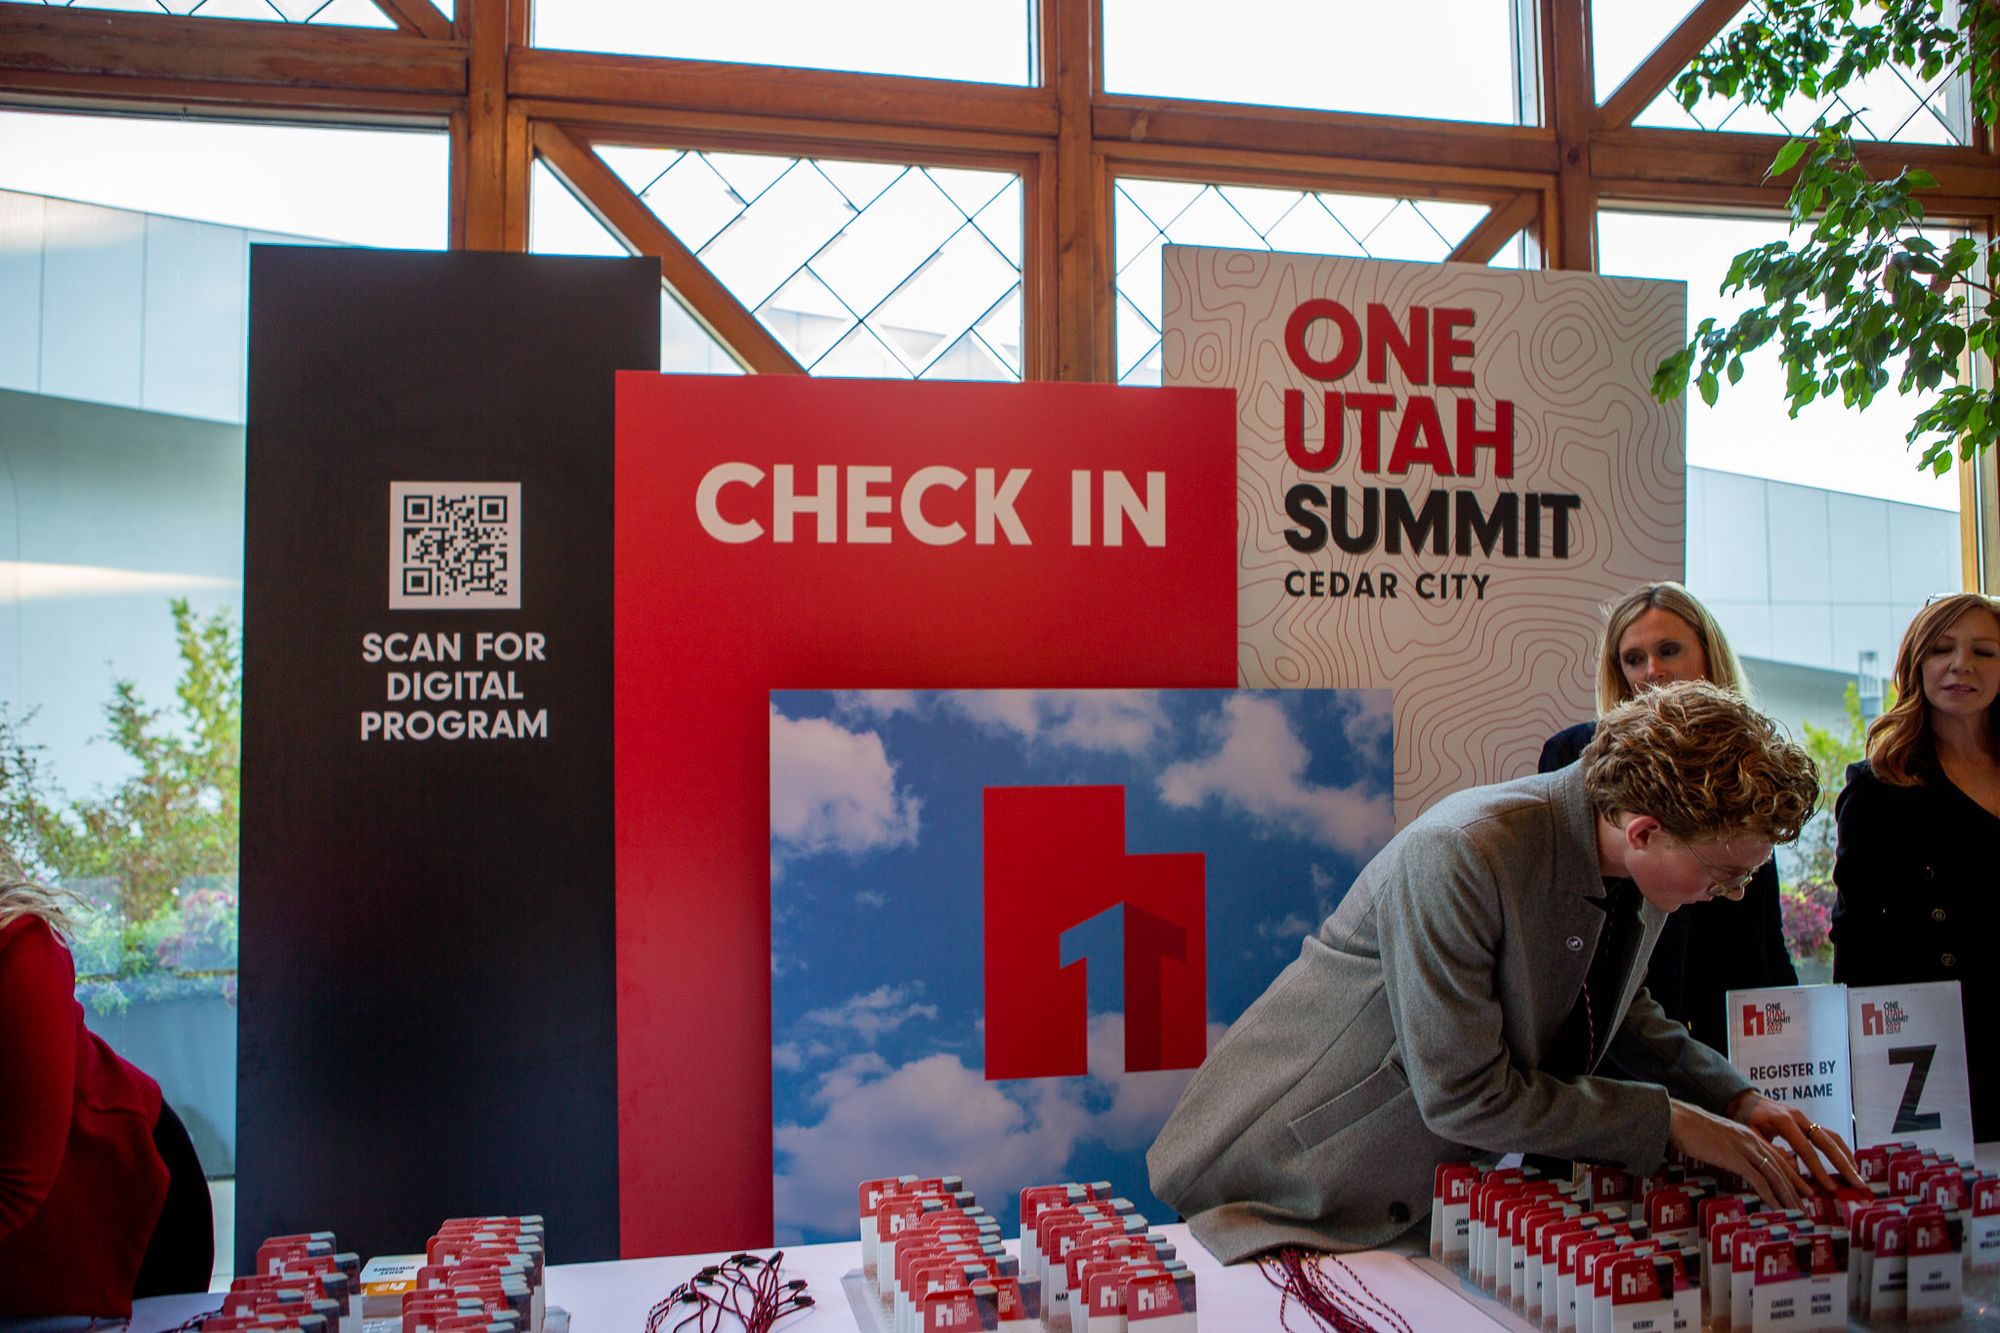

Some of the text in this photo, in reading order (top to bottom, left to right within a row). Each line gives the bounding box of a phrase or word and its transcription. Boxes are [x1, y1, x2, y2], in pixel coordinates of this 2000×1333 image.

[1284, 298, 1475, 388] ONE
[1284, 388, 1514, 479] UTAH
[695, 461, 1166, 548] CHECK IN
[1283, 483, 1581, 559] SUMMIT
[1284, 570, 1491, 600] CEDAR CITY
[362, 631, 546, 662] SCAN FOR
[387, 671, 523, 701] DIGITAL
[361, 709, 548, 741] PROGRAM
[1765, 1002, 1781, 1010] ONE
[1766, 1009, 1786, 1017] UTAH
[1884, 1001, 1898, 1010] ONE
[1884, 1008, 1904, 1016] UTAH
[1766, 1016, 1791, 1024] SUMMIT
[1767, 1023, 1782, 1031] 2022
[1885, 1015, 1909, 1023] SUMMIT
[1886, 1022, 1901, 1031] 2022
[1750, 1060, 1836, 1080] REGISTER BY
[1763, 1083, 1833, 1101] AST NAME
[1888, 1044, 1941, 1134] Z
